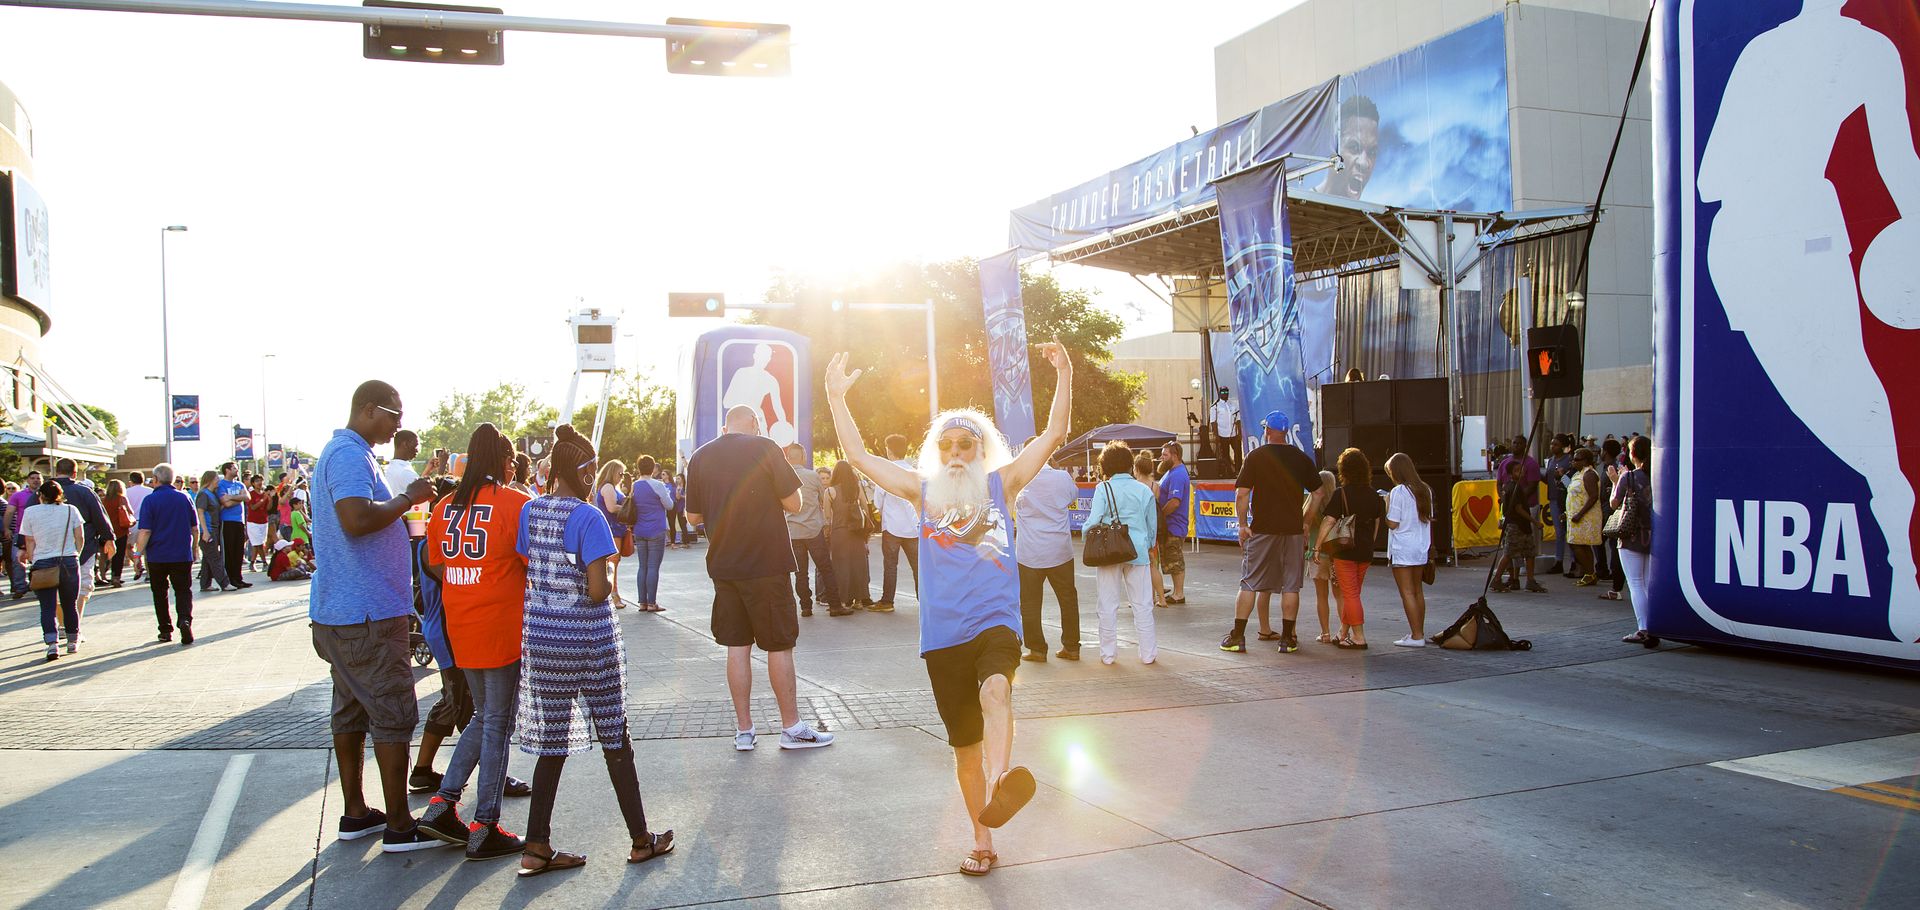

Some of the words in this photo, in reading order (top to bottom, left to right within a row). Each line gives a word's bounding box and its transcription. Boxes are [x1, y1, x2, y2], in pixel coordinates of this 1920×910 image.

[1051, 182, 1120, 237] THUNDER
[1131, 130, 1259, 210] BASKETBALL
[442, 503, 494, 560] 35
[1714, 498, 1871, 598] NBA
